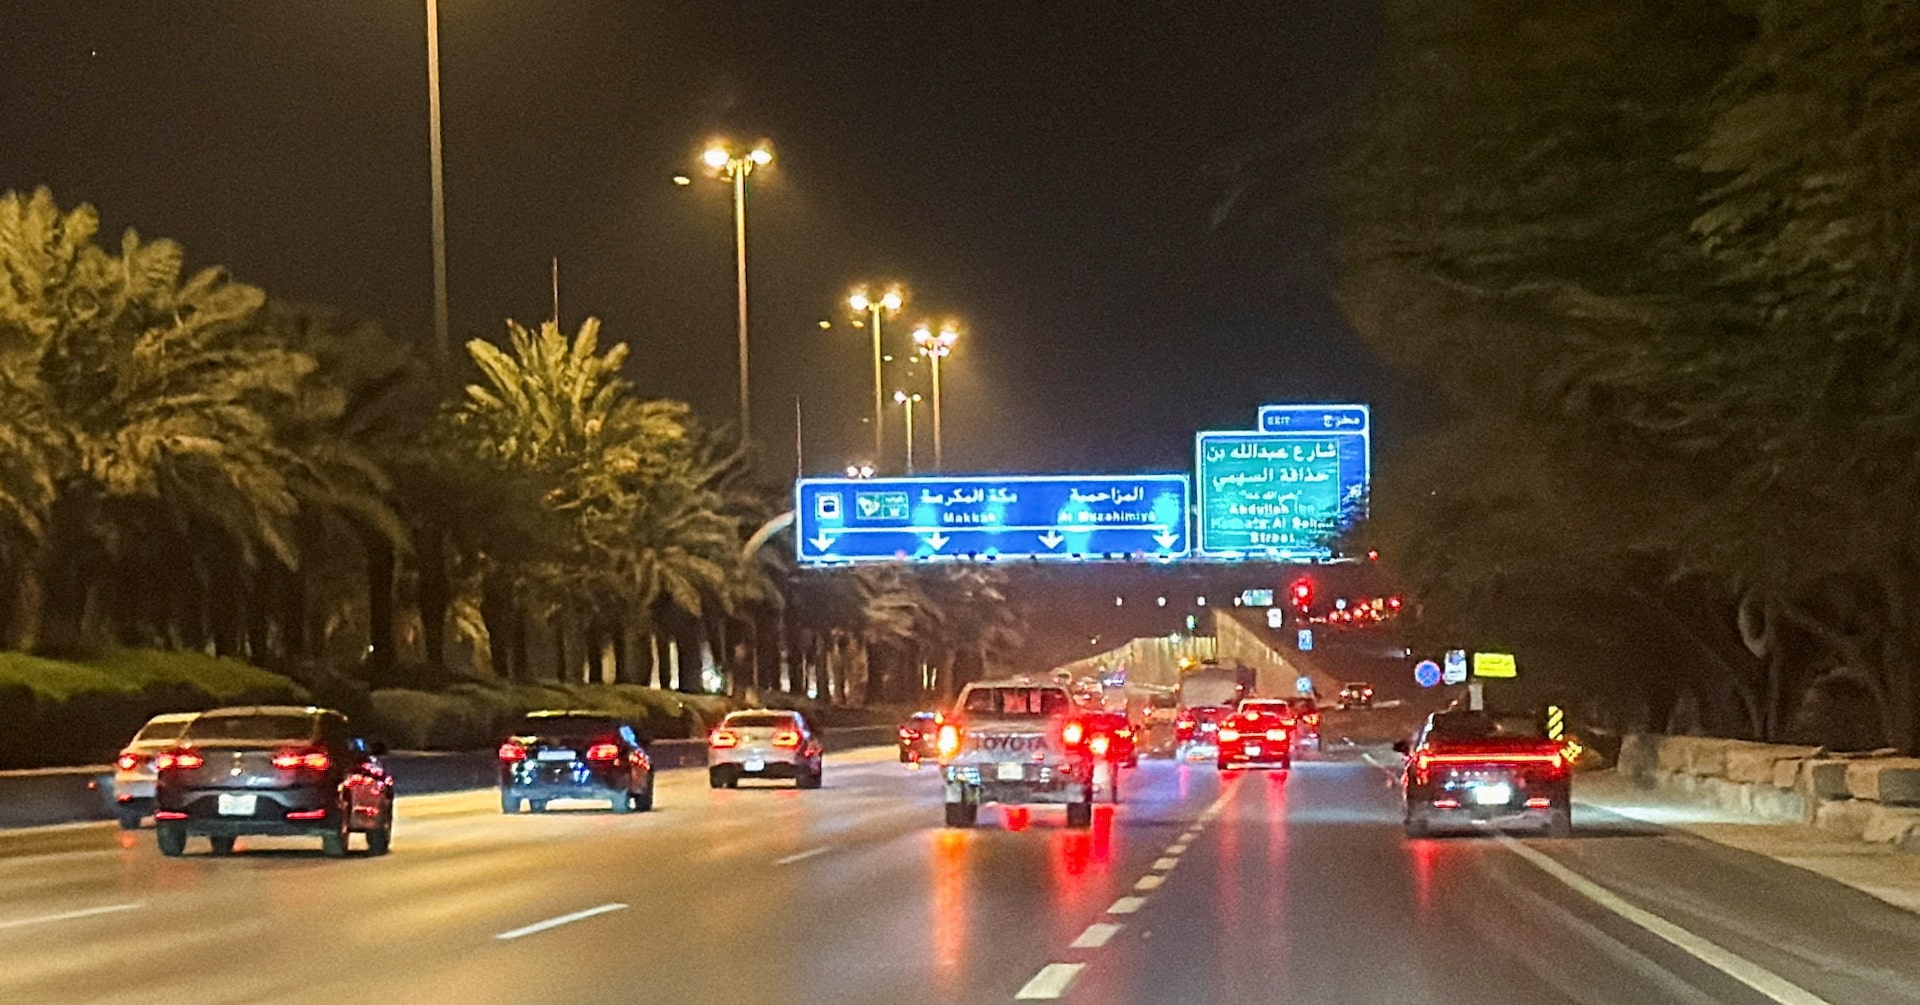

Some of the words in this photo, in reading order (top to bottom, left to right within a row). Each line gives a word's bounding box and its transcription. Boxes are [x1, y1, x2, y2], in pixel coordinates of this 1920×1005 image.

[1267, 416, 1291, 426] EXIT
[1323, 414, 1361, 428] مخرج
[1206, 444, 1226, 462] بن
[1230, 442, 1289, 461] عبدالله
[1293, 442, 1337, 462] شارع
[1212, 467, 1274, 491] السهمي
[1279, 467, 1330, 483] حذافة
[921, 488, 985, 506] المكرمة
[986, 487, 1018, 503] مكة
[1069, 486, 1145, 505] المزاحمية
[943, 511, 997, 523] Makkah
[1229, 503, 1290, 515] Abdullah
[1250, 532, 1296, 544] Street
[971, 736, 1049, 751] TOYOTA
